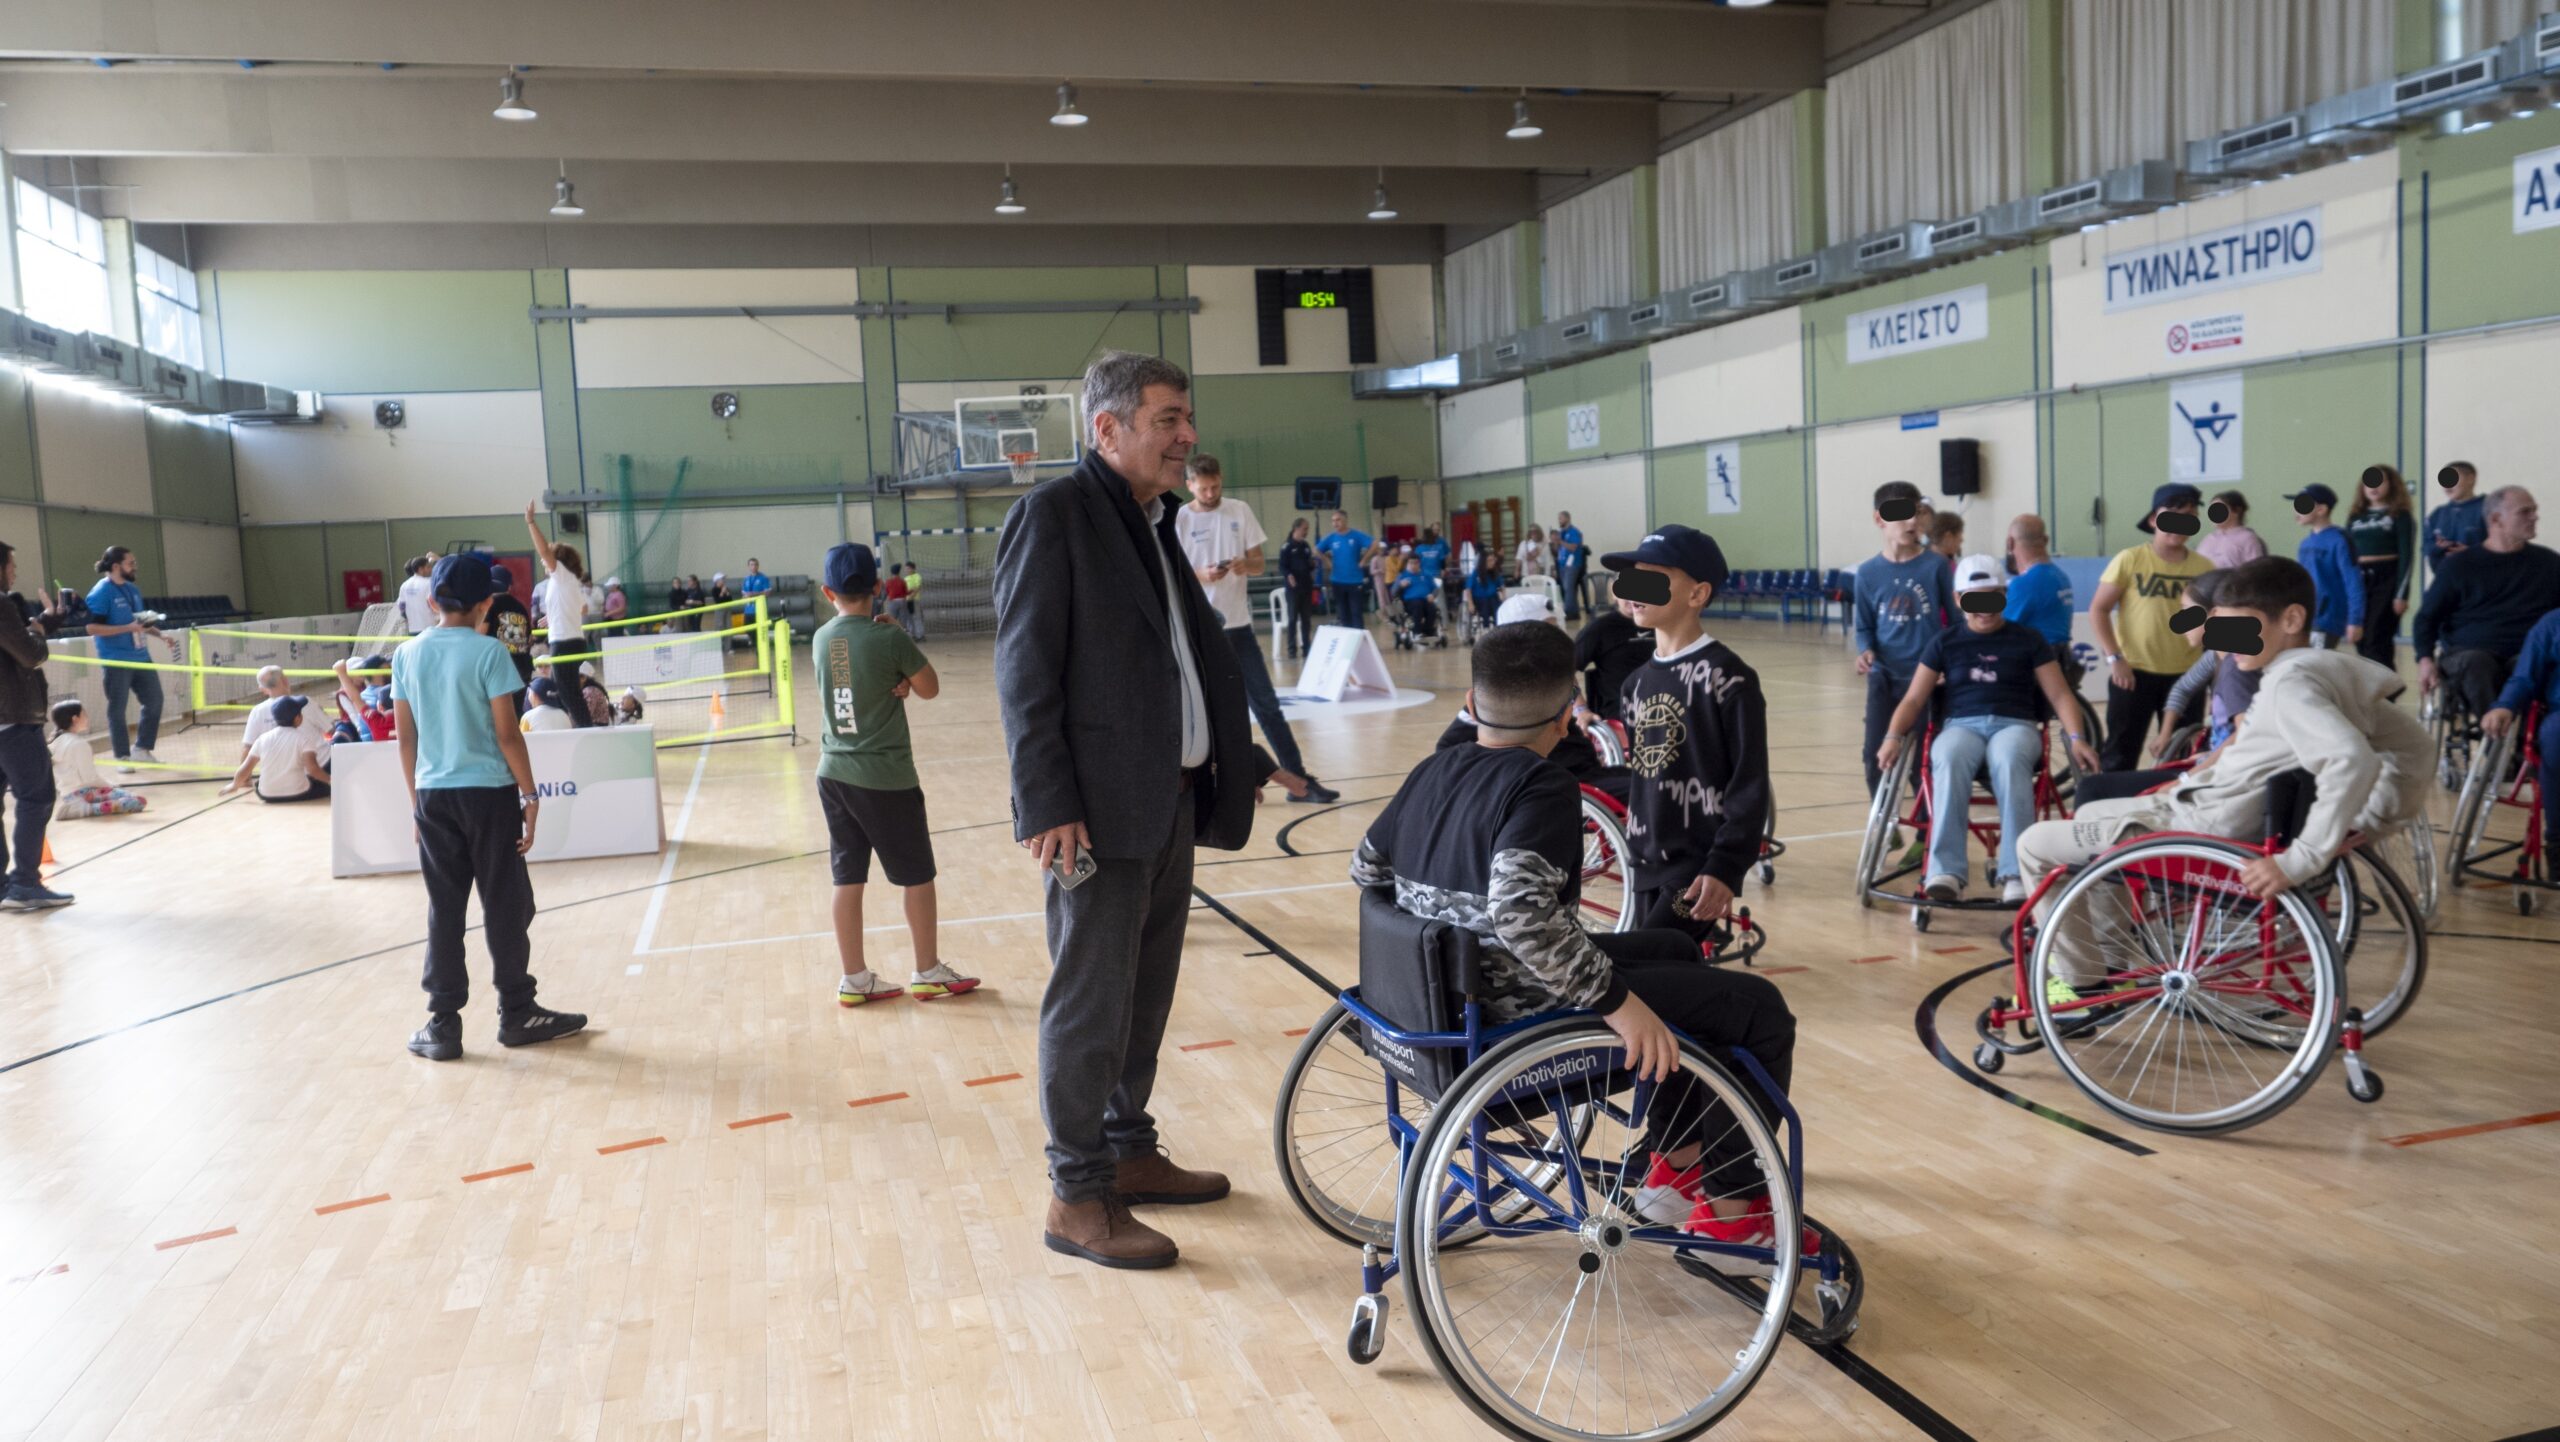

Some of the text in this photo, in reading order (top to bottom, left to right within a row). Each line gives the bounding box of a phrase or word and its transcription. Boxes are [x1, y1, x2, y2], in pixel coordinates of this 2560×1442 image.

[2107, 219, 2314, 302] ΓΥΜΝΑΣΤΗΡΙΟ
[1301, 292, 1335, 307] 10:54
[1868, 301, 1960, 349] ΚΛΕΙΣΤΟ
[2135, 572, 2194, 599] VAN
[2183, 871, 2248, 895] motivatio
[1379, 1049, 1416, 1077] motivation
[1511, 1054, 1598, 1090] motivation
